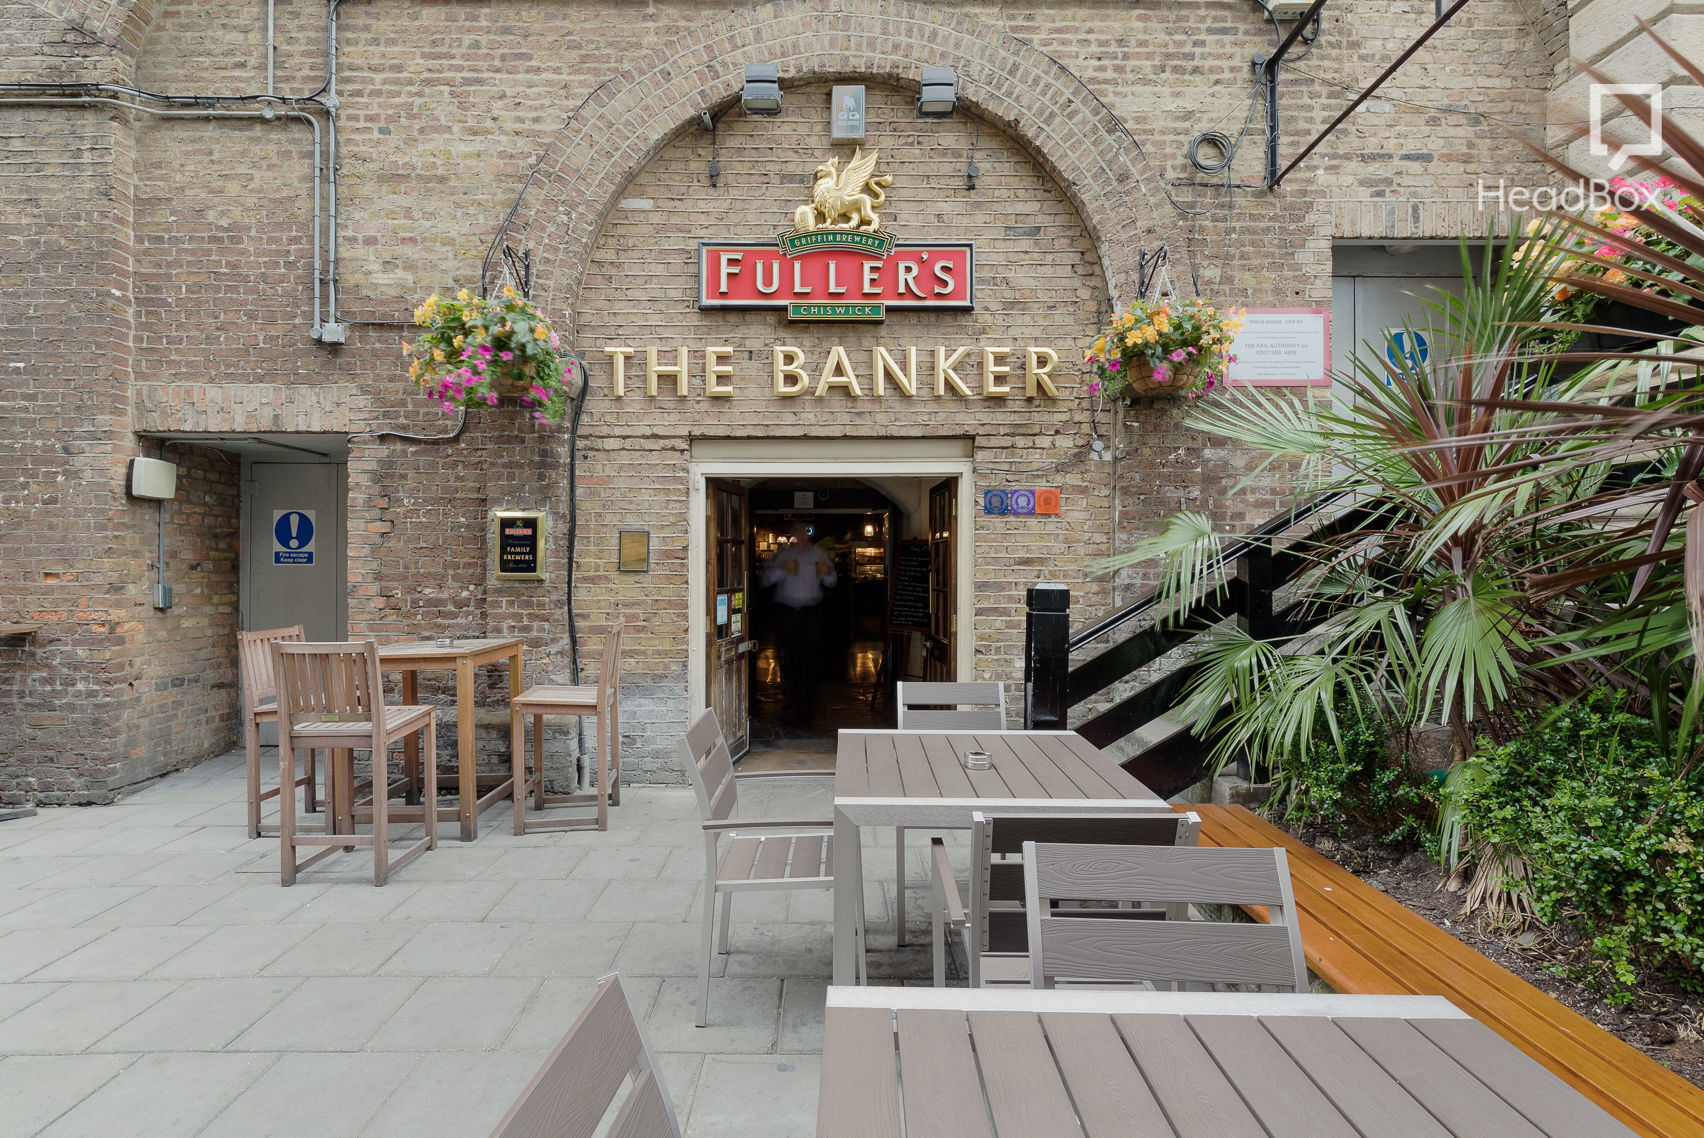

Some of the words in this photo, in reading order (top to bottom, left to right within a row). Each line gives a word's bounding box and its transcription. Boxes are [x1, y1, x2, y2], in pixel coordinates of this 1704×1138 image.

[794, 234, 834, 247] GRIFFIN
[836, 234, 880, 247] BREWERY
[718, 251, 956, 299] FULLER'S
[800, 306, 873, 315] CHISWICK
[604, 346, 734, 397] THE
[773, 346, 1060, 397] BANKER
